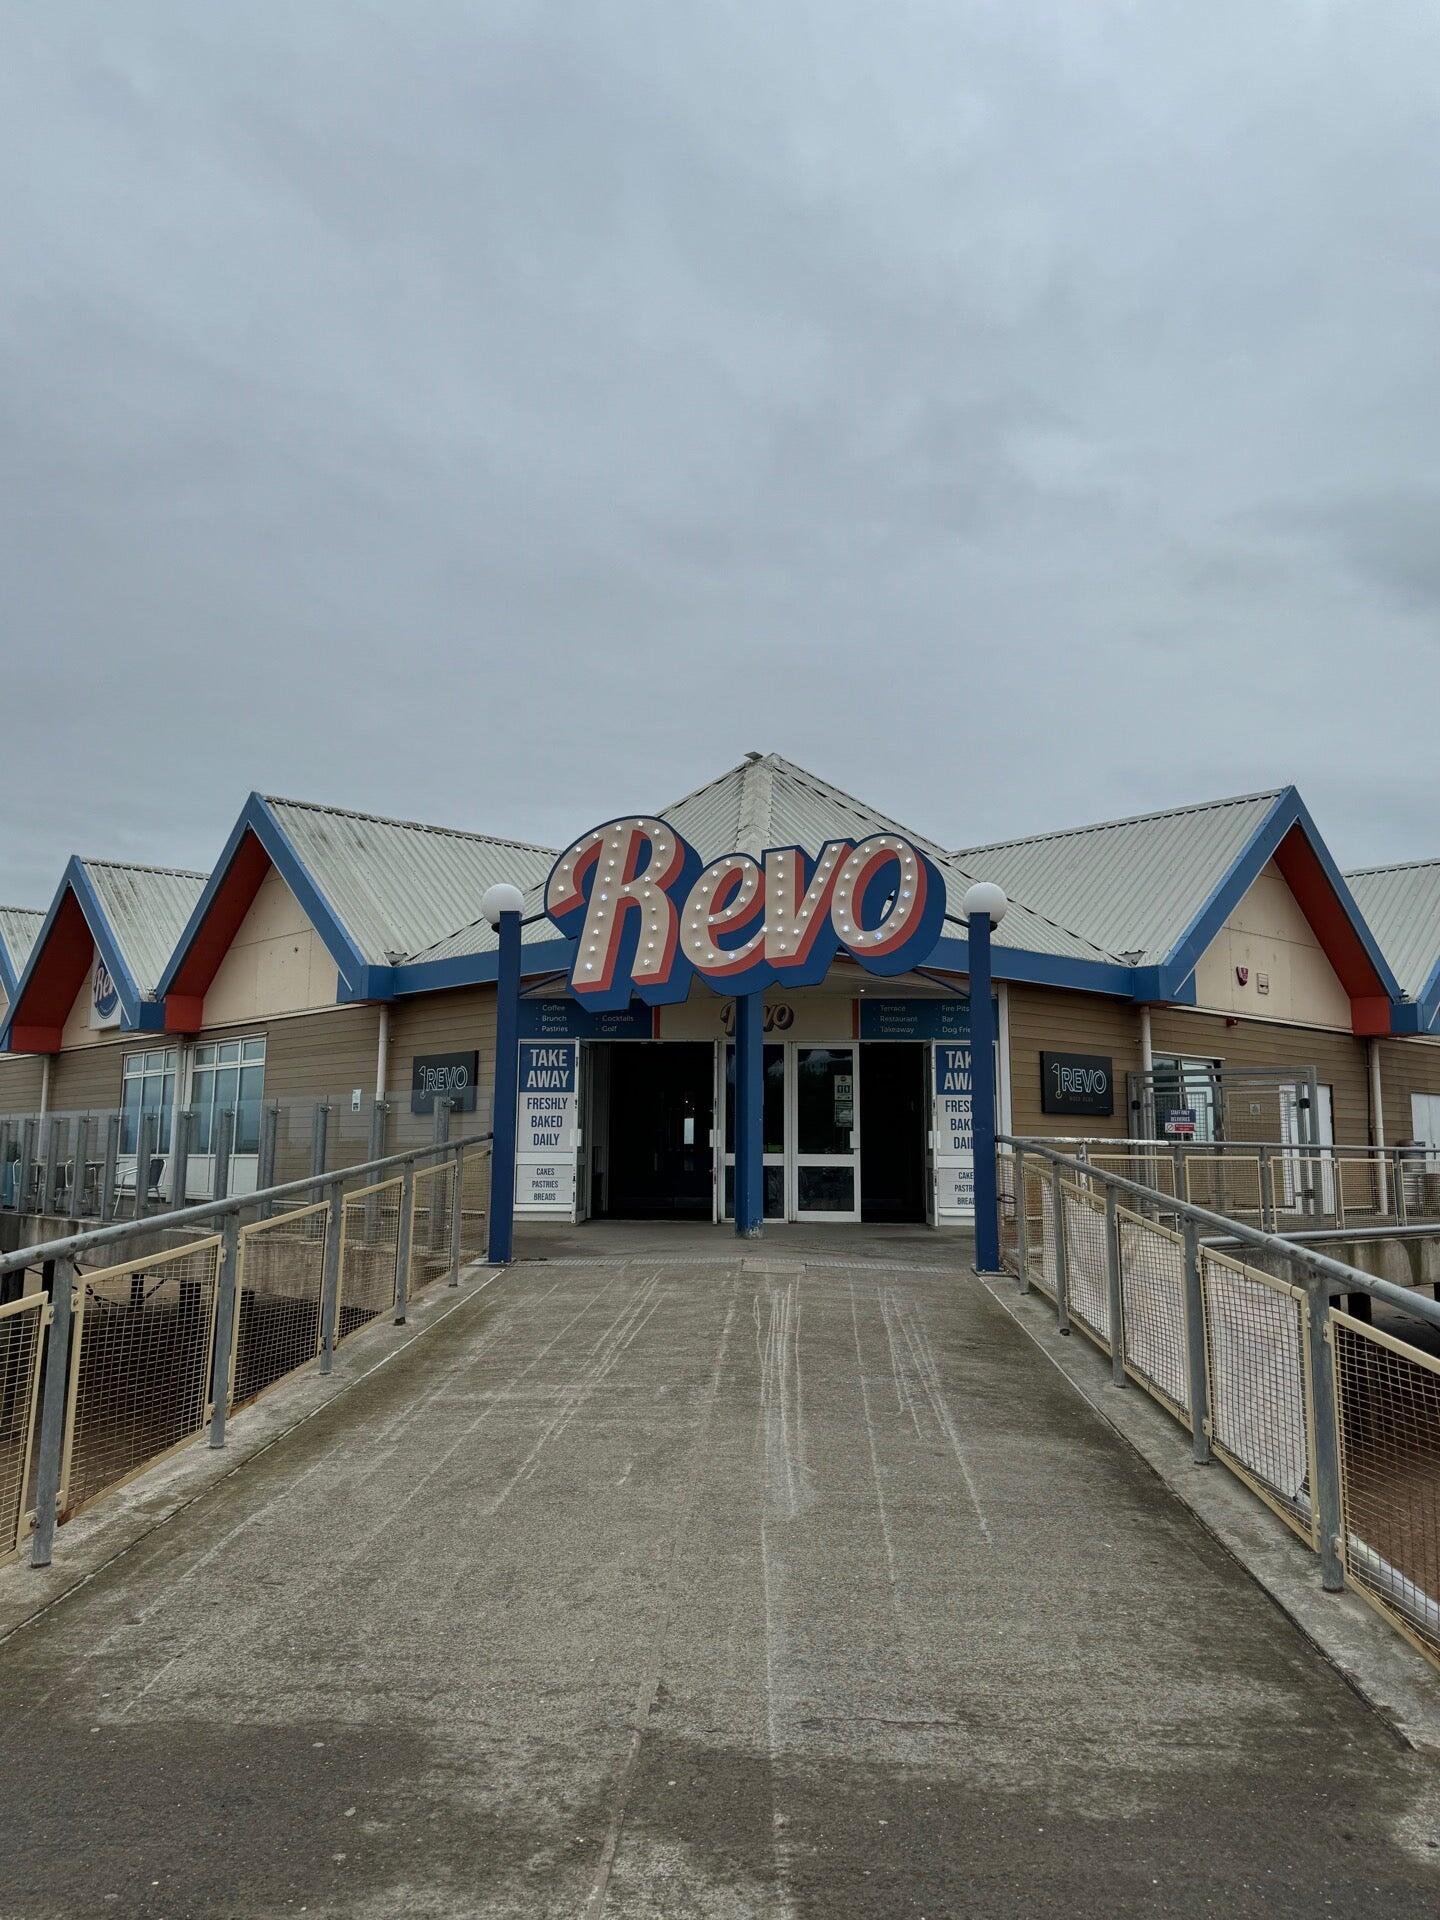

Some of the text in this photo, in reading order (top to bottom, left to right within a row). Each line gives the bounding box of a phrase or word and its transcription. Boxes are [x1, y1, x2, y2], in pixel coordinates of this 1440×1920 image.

[546, 816, 928, 994] Revo
[542, 1004, 566, 1012] Coffee
[880, 1026, 914, 1034] Takeaway
[942, 1026, 957, 1034] Dog
[530, 1049, 568, 1067] TAKE
[945, 1050, 972, 1069] TAK
[526, 1070, 570, 1088] AWAY
[527, 1097, 568, 1110] FRESHLY
[945, 1100, 972, 1112] FRES
[531, 1115, 563, 1128] BAKED
[950, 1118, 972, 1131] BAK
[533, 1133, 560, 1146] DAILY
[536, 1168, 555, 1176] CAKES
[531, 1180, 559, 1188] PASTRIES
[533, 1192, 556, 1201] BREADS
